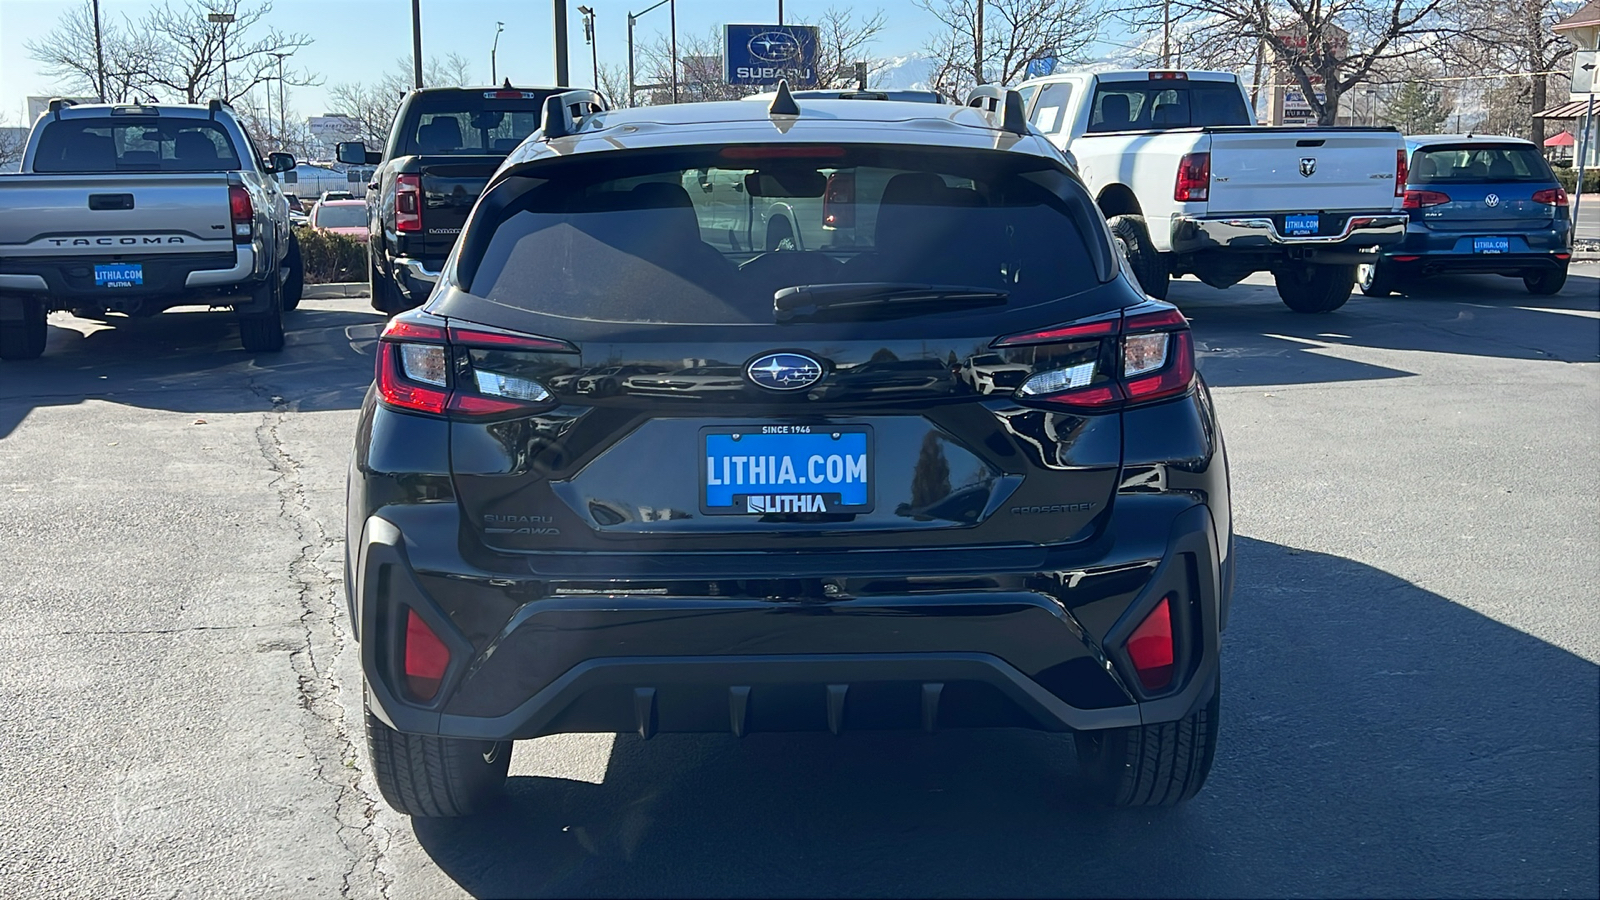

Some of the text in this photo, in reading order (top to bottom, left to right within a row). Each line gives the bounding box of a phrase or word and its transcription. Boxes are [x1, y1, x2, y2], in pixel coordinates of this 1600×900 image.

[737, 67, 810, 79] SUBARU
[49, 236, 185, 247] TACOMA
[95, 270, 142, 281] LITHIA.COM
[762, 426, 789, 434] SINCE
[707, 454, 867, 486] LITHIA.COM
[765, 494, 827, 513] LITHIA
[1011, 502, 1097, 515] CROSSTREK
[484, 514, 554, 524] SUBARU
[513, 527, 560, 535] AWD
